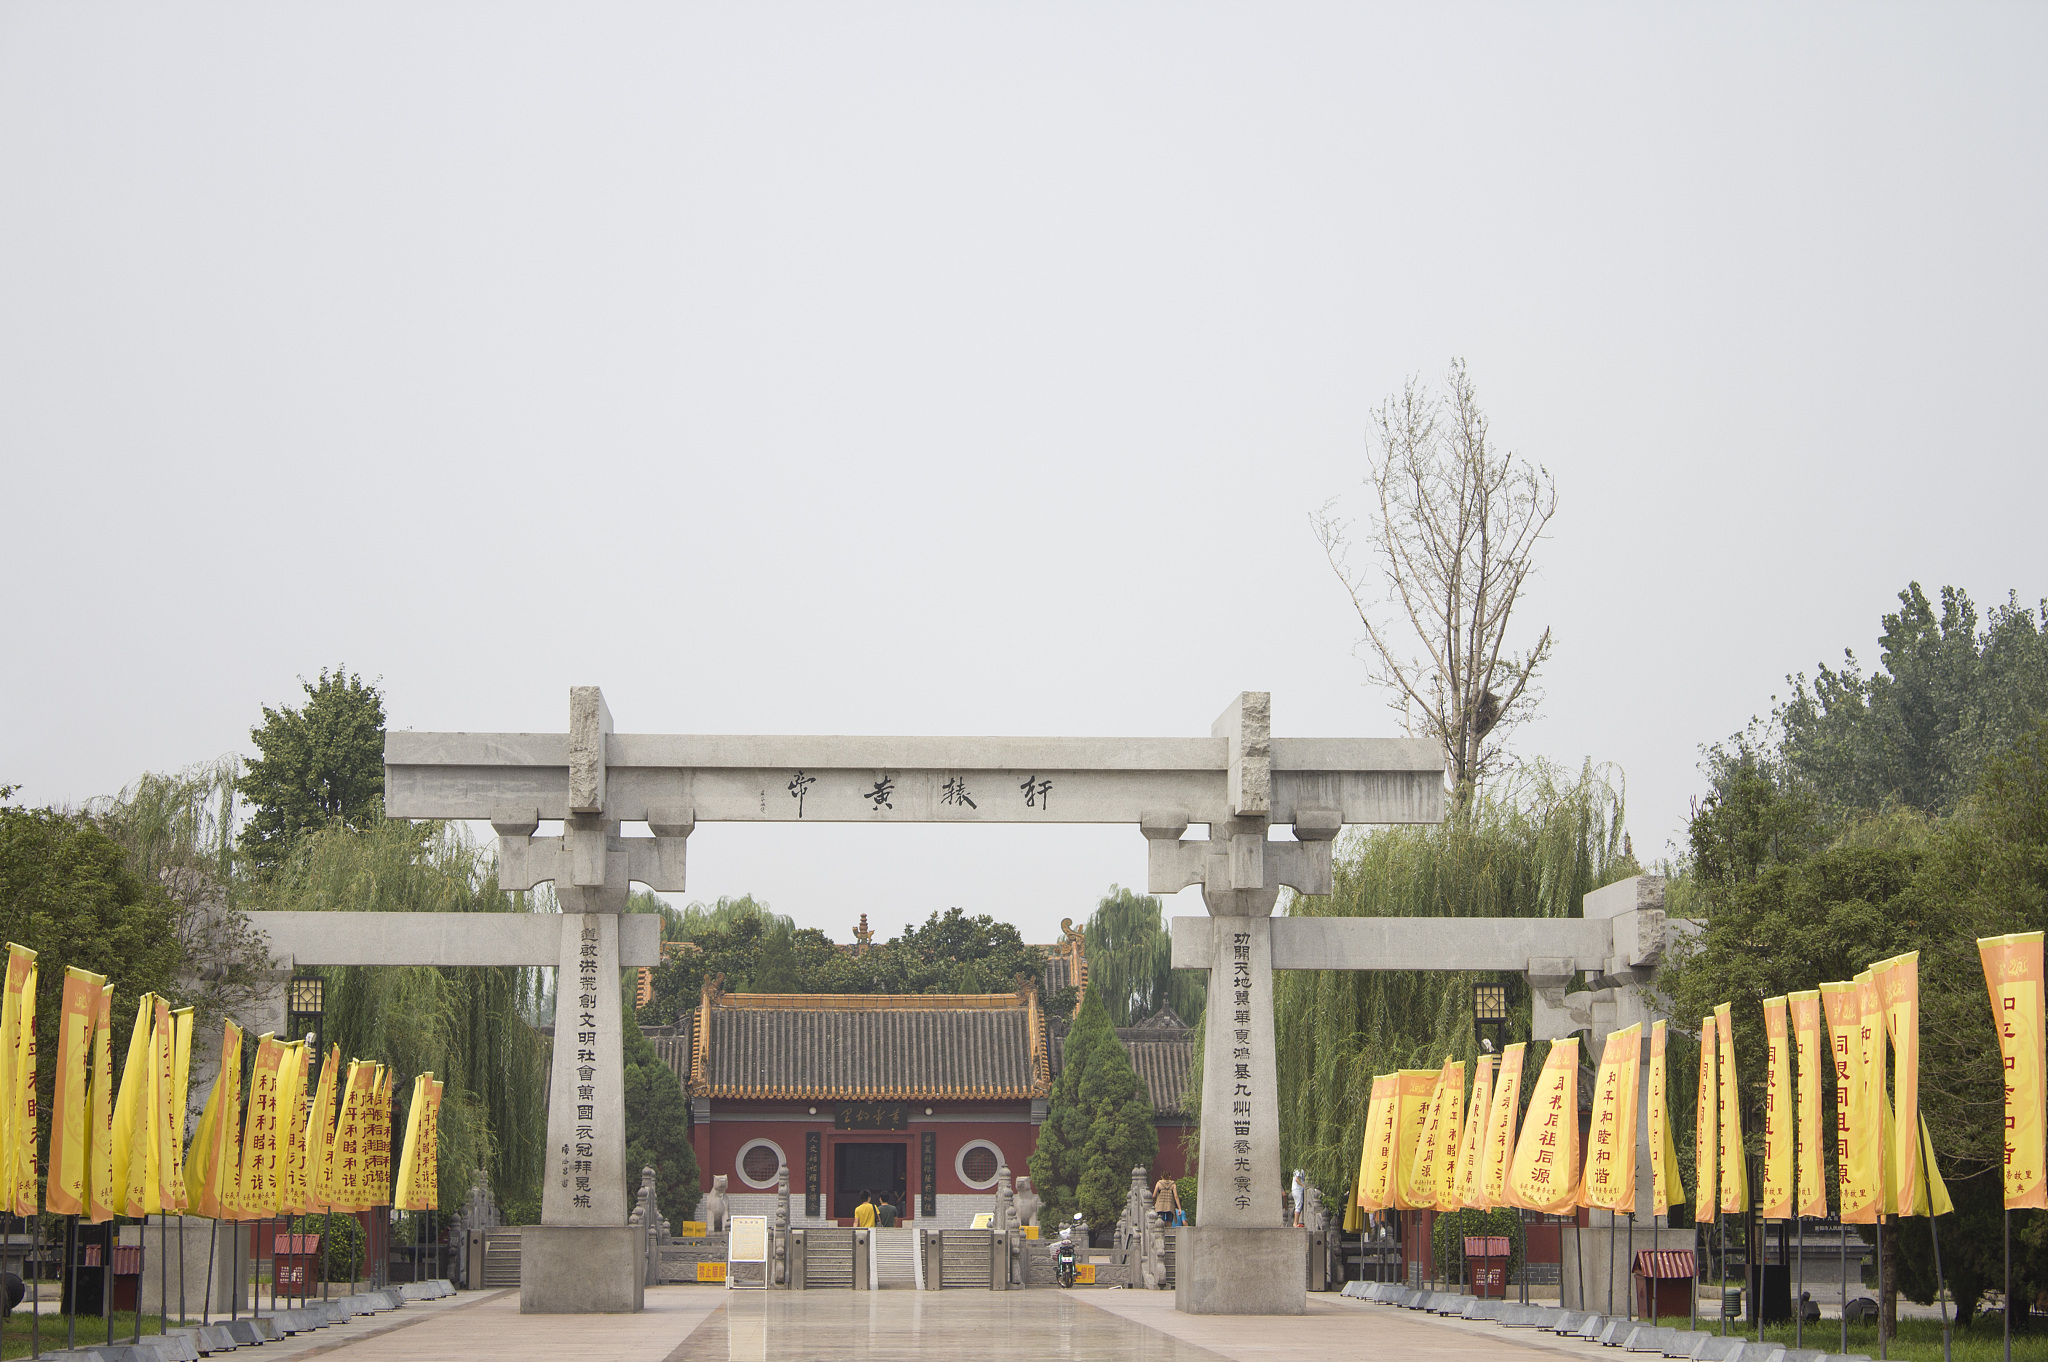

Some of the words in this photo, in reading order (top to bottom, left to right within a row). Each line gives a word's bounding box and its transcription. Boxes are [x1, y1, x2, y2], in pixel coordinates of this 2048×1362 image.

[1531, 1076, 1564, 1184] 同根同祖同源
[1594, 1071, 1616, 1185] 和平和睦和谐
